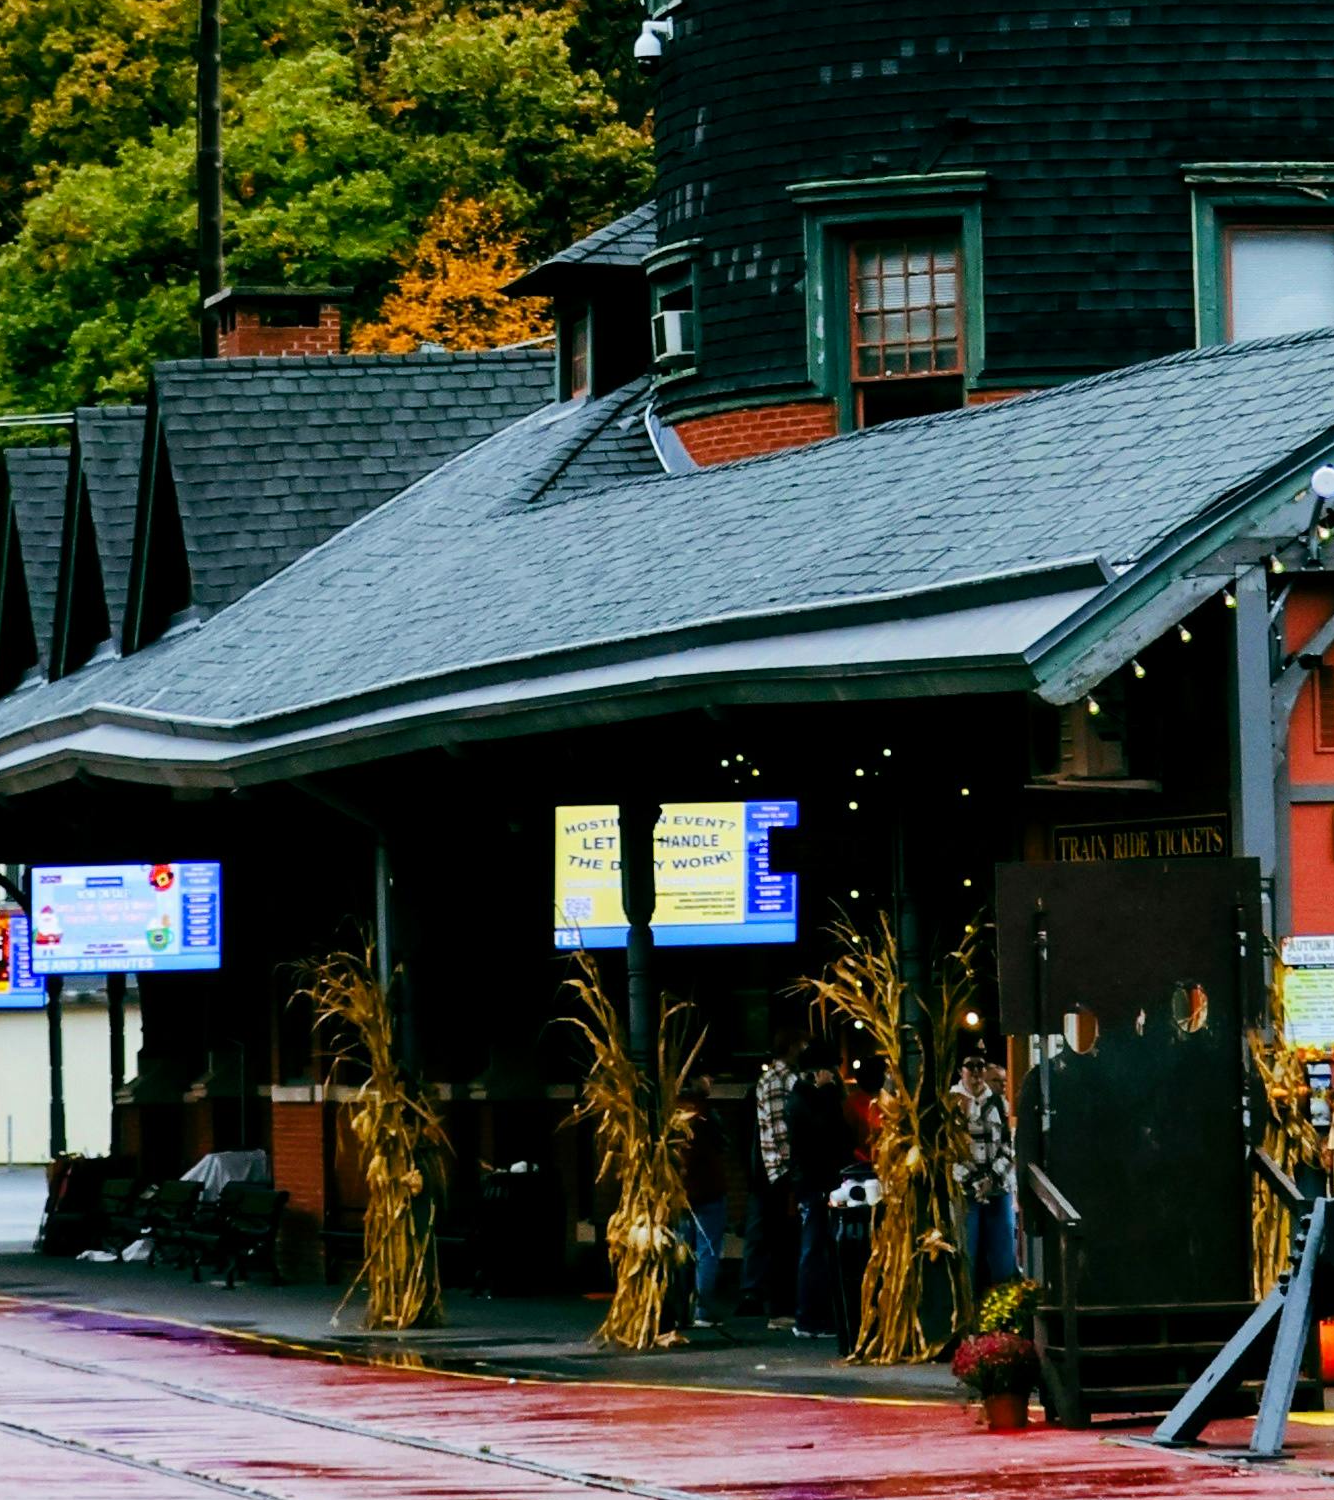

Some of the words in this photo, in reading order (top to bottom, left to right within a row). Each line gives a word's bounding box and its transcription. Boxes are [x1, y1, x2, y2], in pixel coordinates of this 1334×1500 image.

[564, 817, 620, 835] HOSTI
[673, 815, 737, 830] EVENT?
[582, 836, 617, 850] LET
[660, 833, 720, 848] HANDLE
[1058, 834, 1107, 862] TRAIN
[1113, 831, 1150, 860] RIDE
[1155, 825, 1224, 857] TICKETS
[568, 854, 605, 870] THE
[671, 850, 734, 869] WORK!
[1288, 939, 1331, 951] AUTUMN
[51, 959, 78, 971] AND
[99, 957, 155, 970] MINUTES
